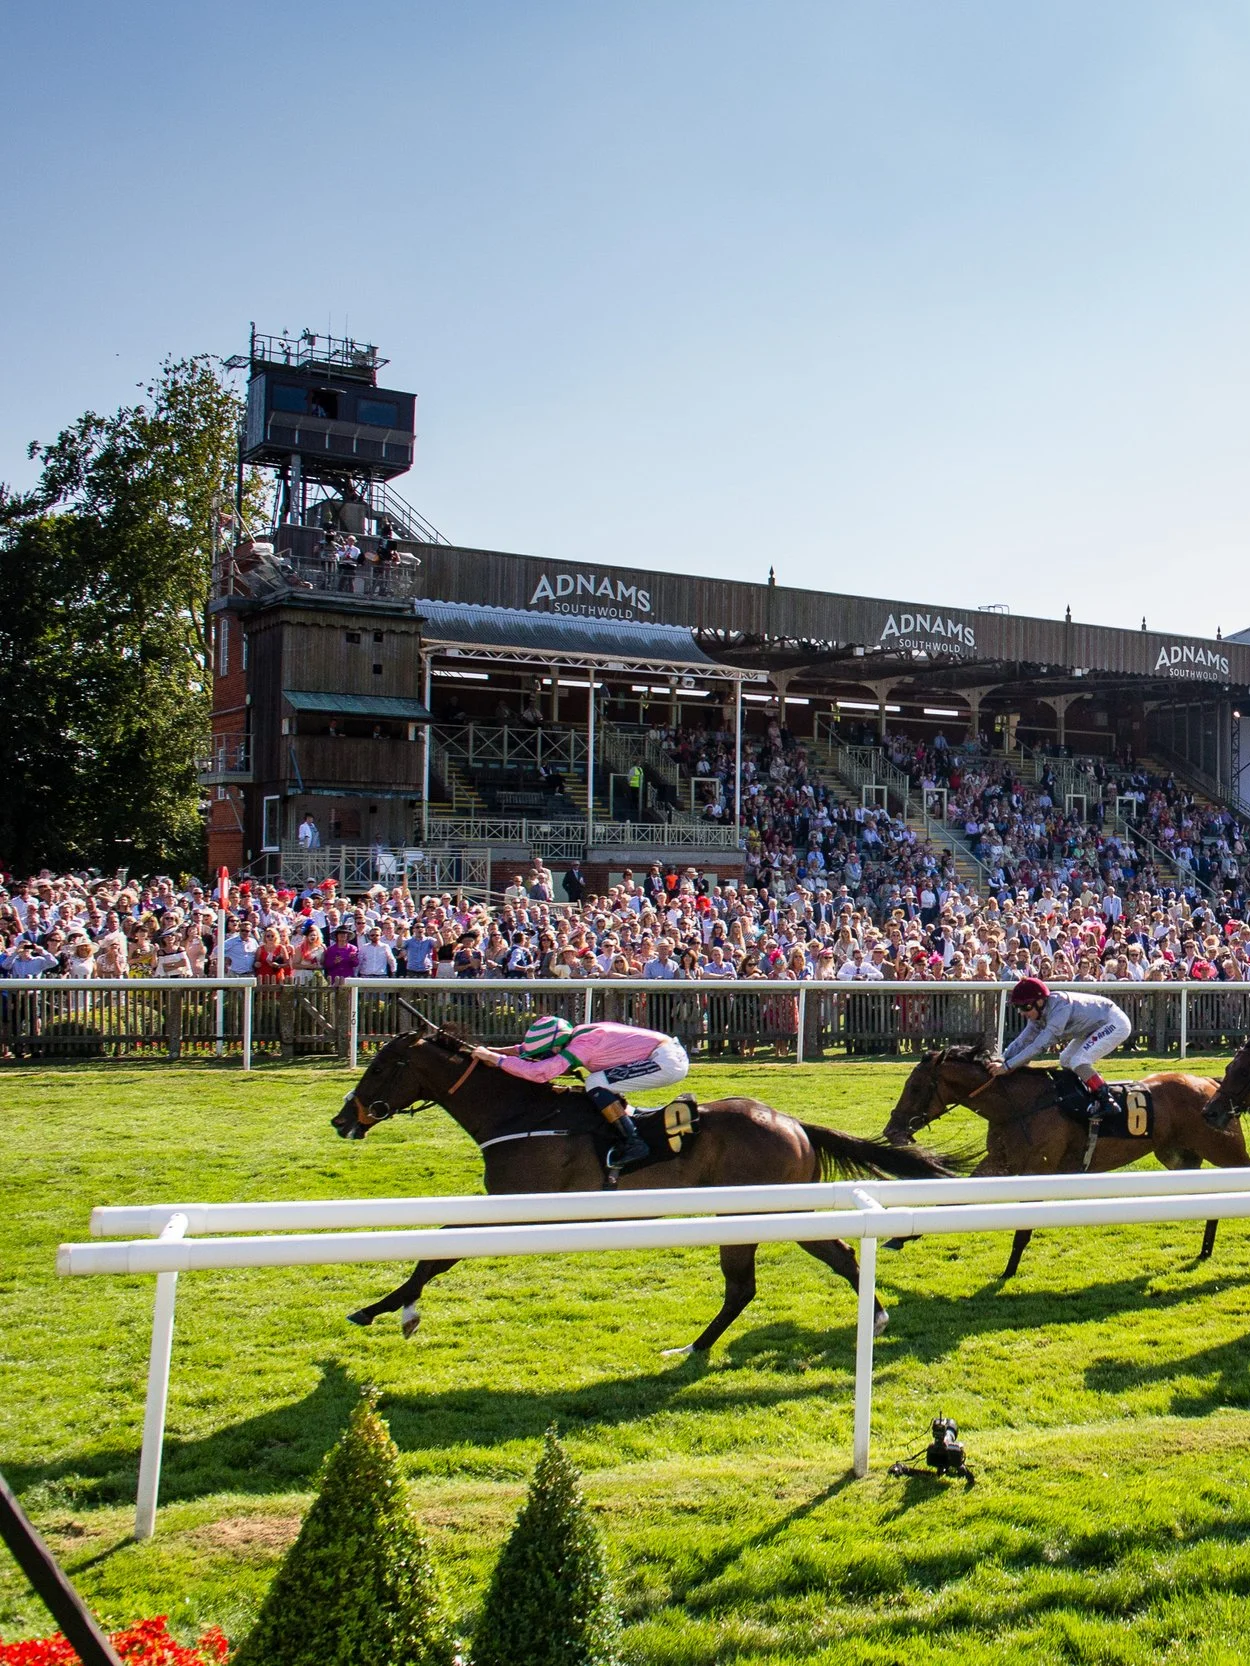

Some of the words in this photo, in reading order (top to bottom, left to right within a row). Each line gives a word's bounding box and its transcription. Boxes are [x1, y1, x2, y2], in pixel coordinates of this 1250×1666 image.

[529, 573, 652, 613] ADNAMS
[554, 602, 633, 619] SOUTHWOLD
[880, 613, 975, 647] ADNAMS
[899, 638, 961, 653] SOUTHWOLD
[1154, 645, 1229, 675] ADNAMS
[1169, 667, 1218, 681] SOUTHWOLD
[664, 1102, 694, 1153] 9
[1126, 1090, 1147, 1136] 6
